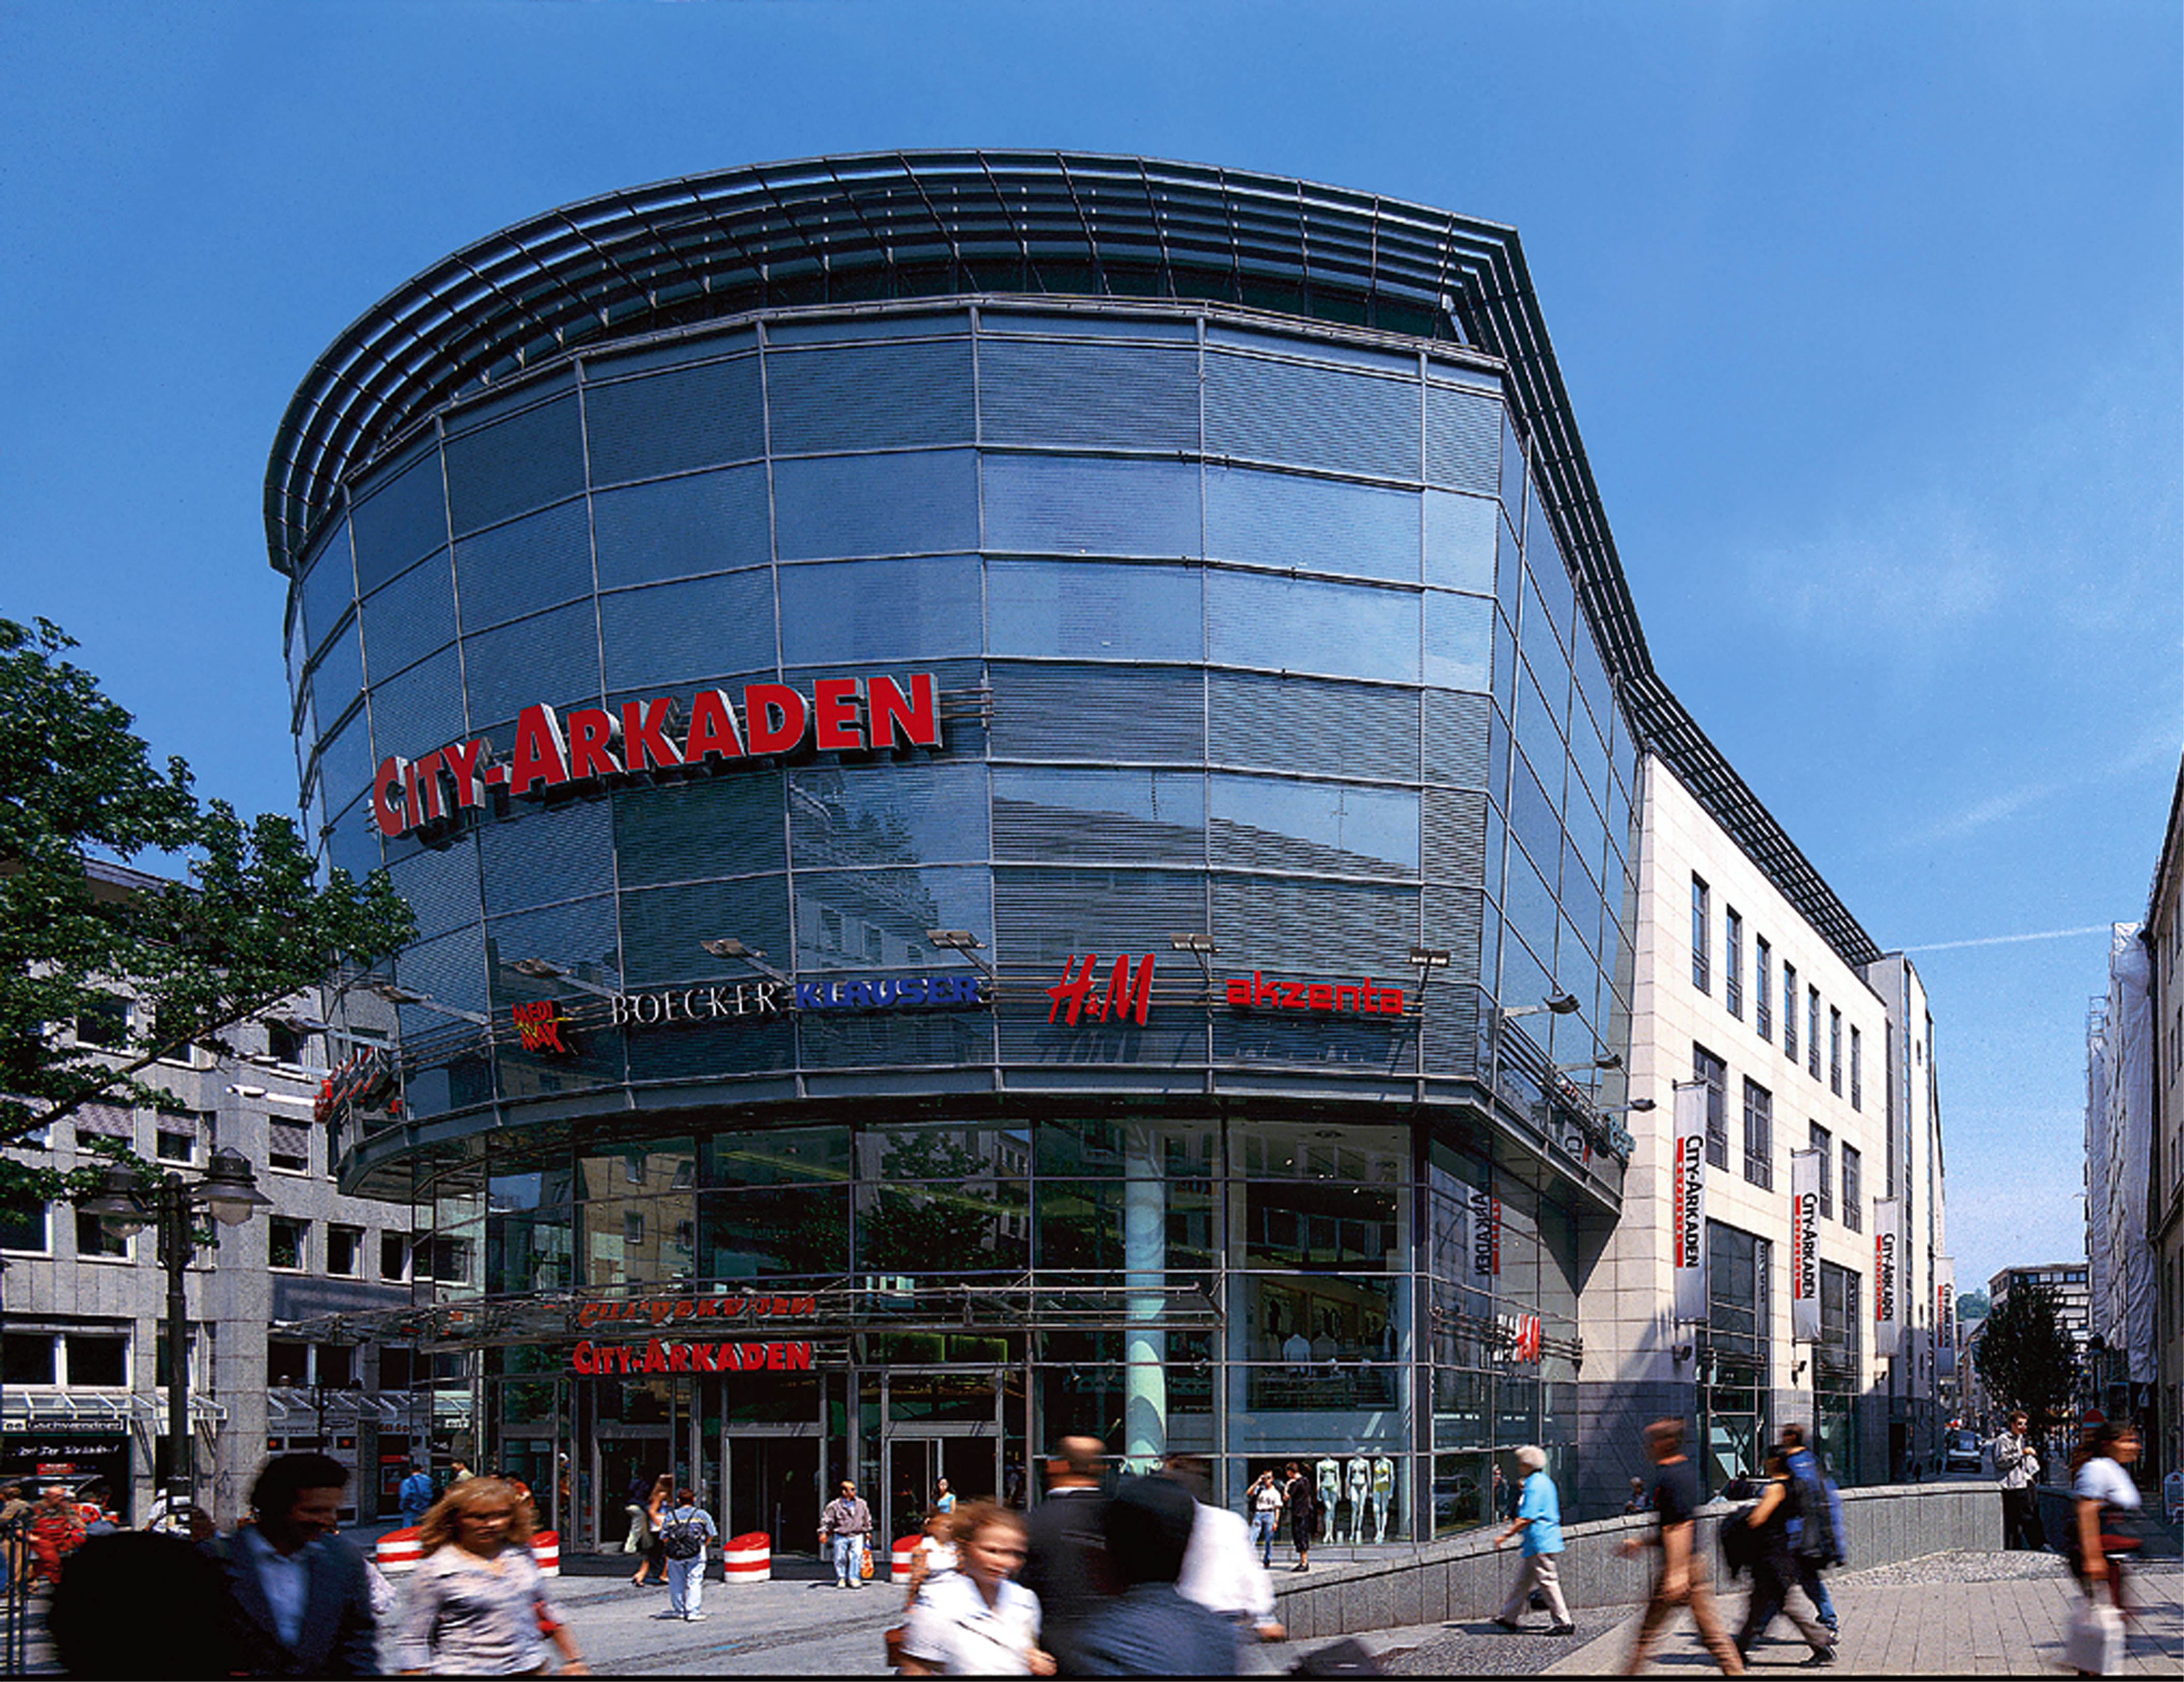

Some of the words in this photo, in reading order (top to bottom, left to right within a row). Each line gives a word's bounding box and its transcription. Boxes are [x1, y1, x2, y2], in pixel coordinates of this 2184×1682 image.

[373, 673, 940, 837] CITY-ARKADEN
[611, 982, 778, 1025] BOECKER
[796, 976, 980, 1008] KLAUSER
[1045, 952, 1156, 1027] H&M
[1226, 970, 1403, 1015] akzenta
[511, 999, 553, 1025] MEDI
[520, 1021, 566, 1053] MAX
[1685, 1135, 1704, 1268] CITY-ARKADEN
[1802, 1192, 1818, 1300] CITY-ARKADEN
[572, 1338, 811, 1375] CITY-ARKADEN
